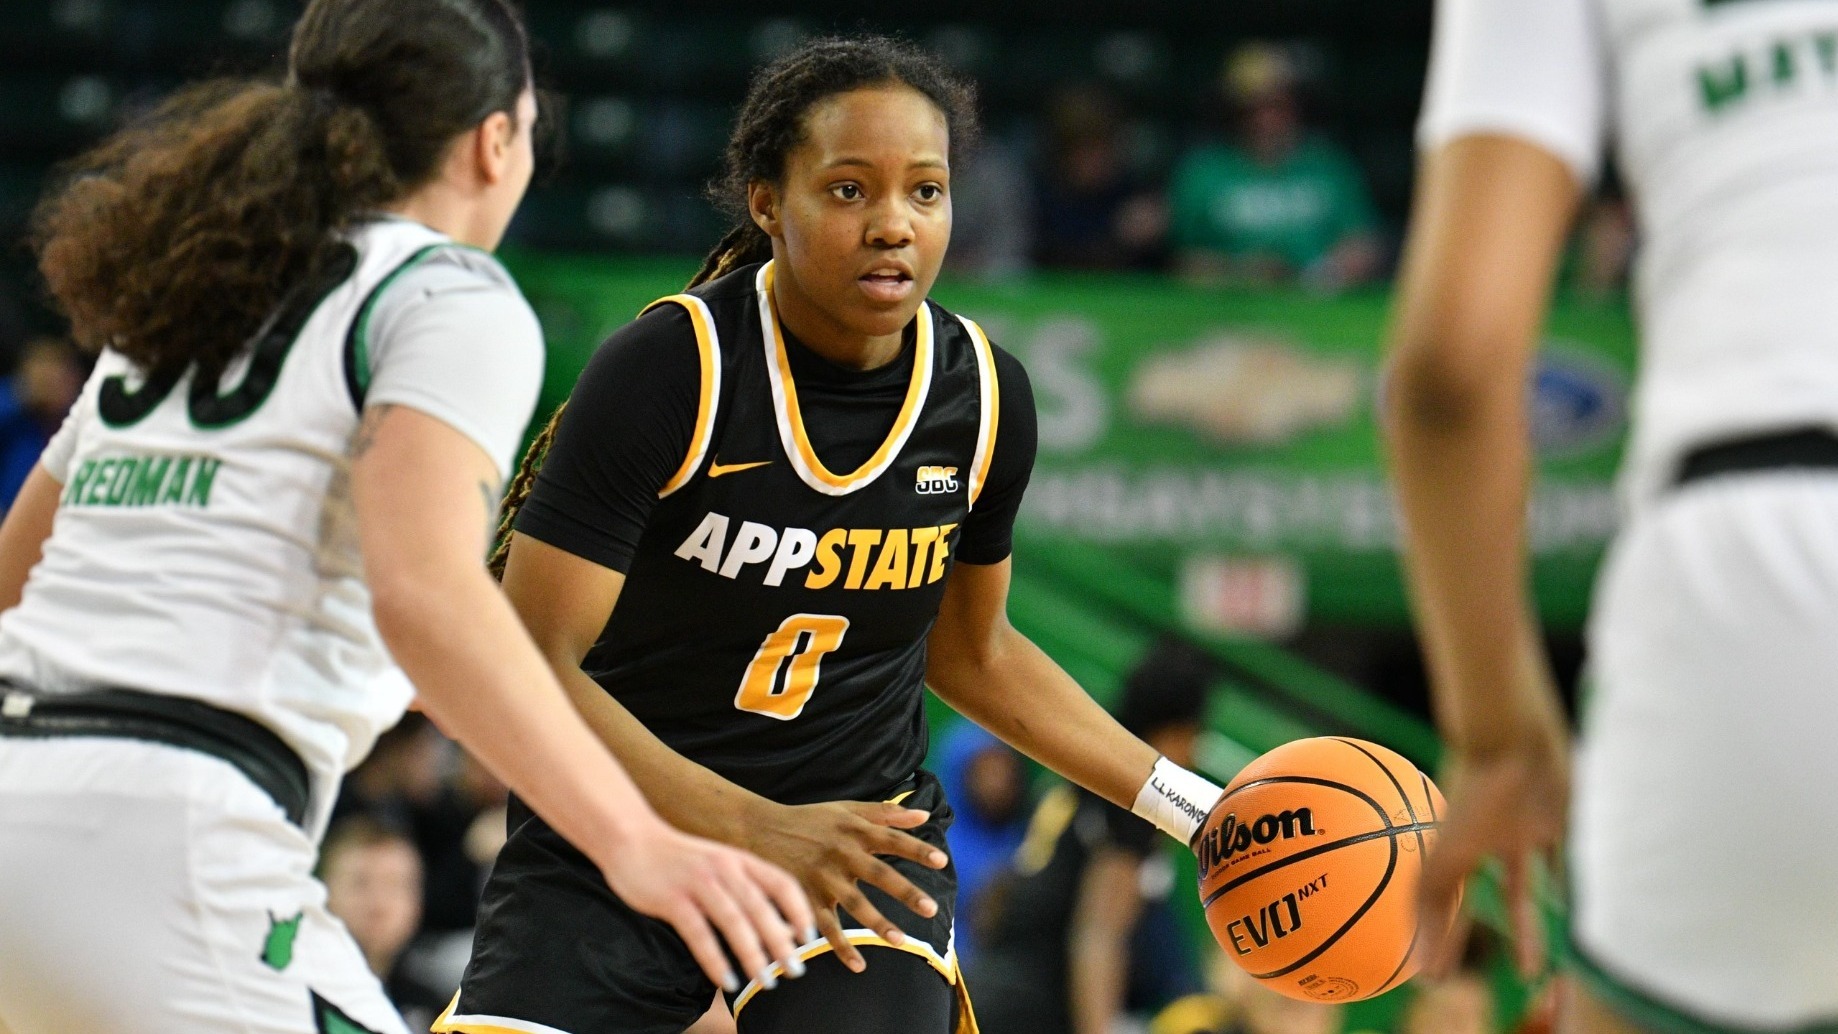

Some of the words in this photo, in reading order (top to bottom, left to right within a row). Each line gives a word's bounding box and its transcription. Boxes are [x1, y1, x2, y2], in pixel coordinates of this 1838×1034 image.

[62, 456, 223, 508] REDMAN
[915, 465, 958, 495] SBC
[733, 612, 850, 721] 0
[1297, 872, 1328, 902] NXT
